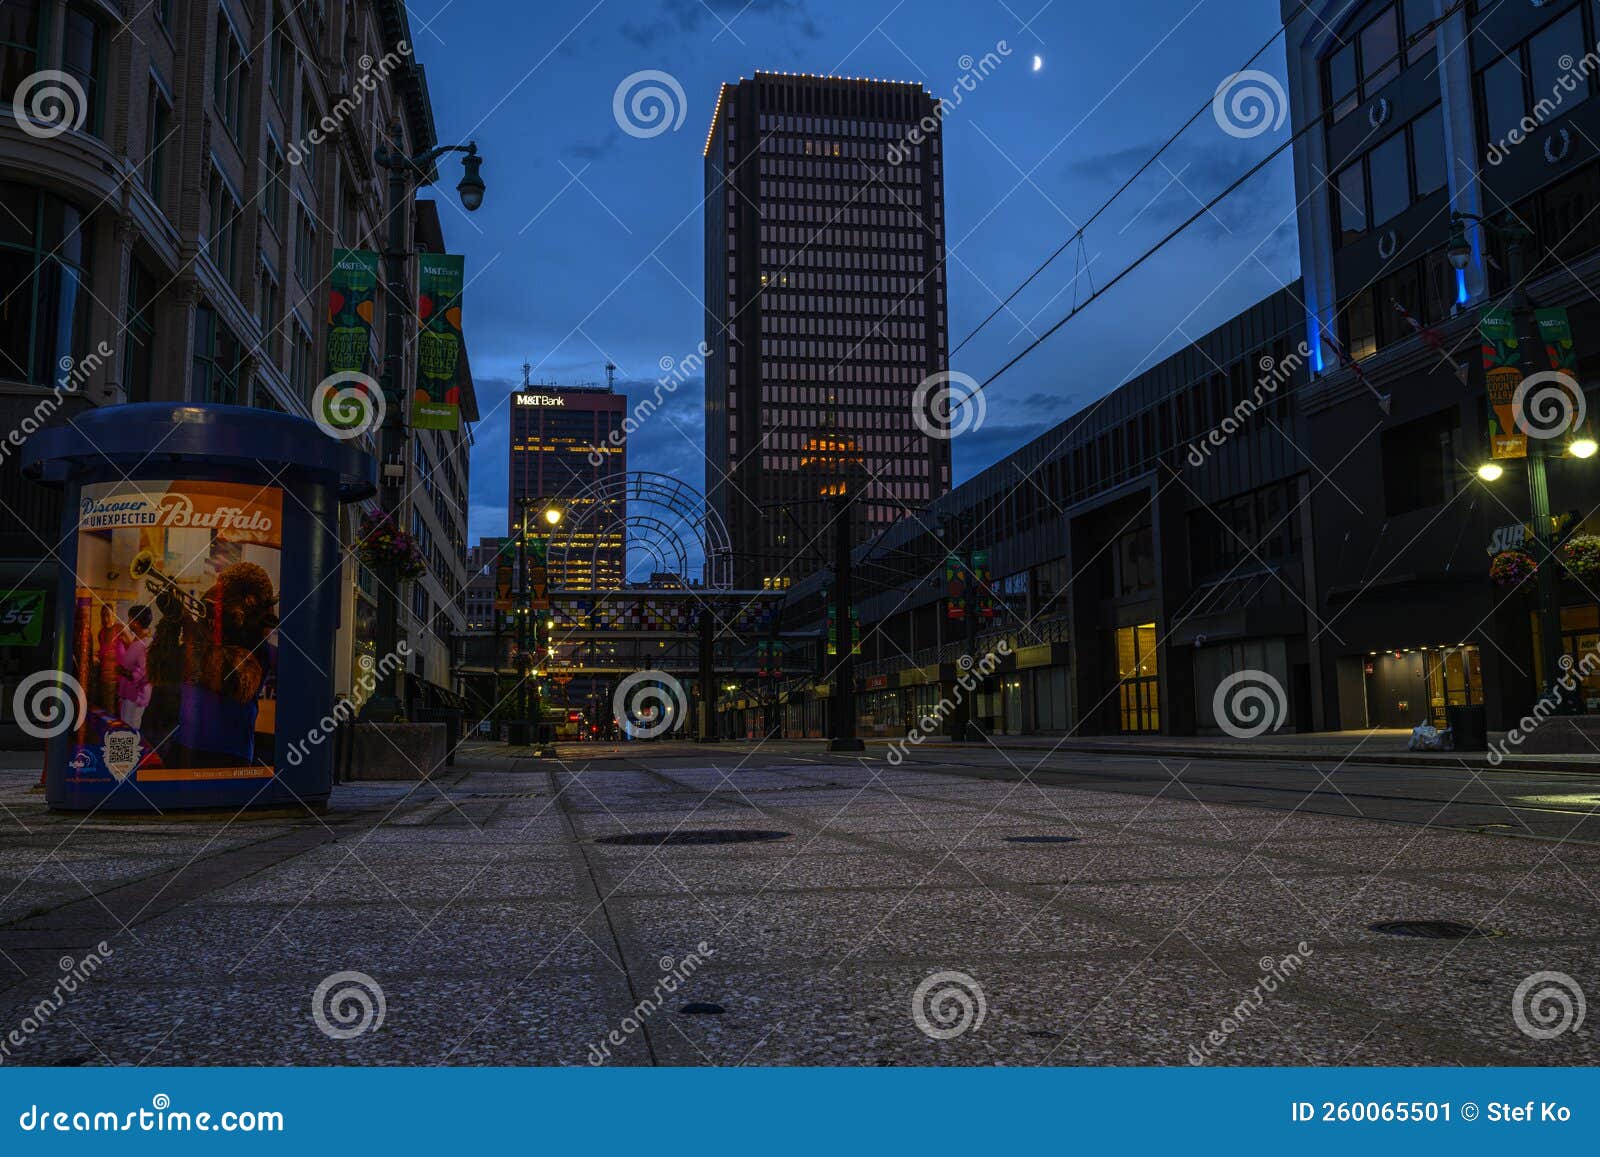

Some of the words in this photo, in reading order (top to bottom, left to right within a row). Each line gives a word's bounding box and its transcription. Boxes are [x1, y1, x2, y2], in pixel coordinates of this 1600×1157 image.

[516, 394, 541, 406] M&T
[541, 395, 566, 406] Bank
[81, 497, 147, 515] Discover
[158, 492, 272, 532] Buffalo
[90, 512, 156, 527] UNEXPECTED
